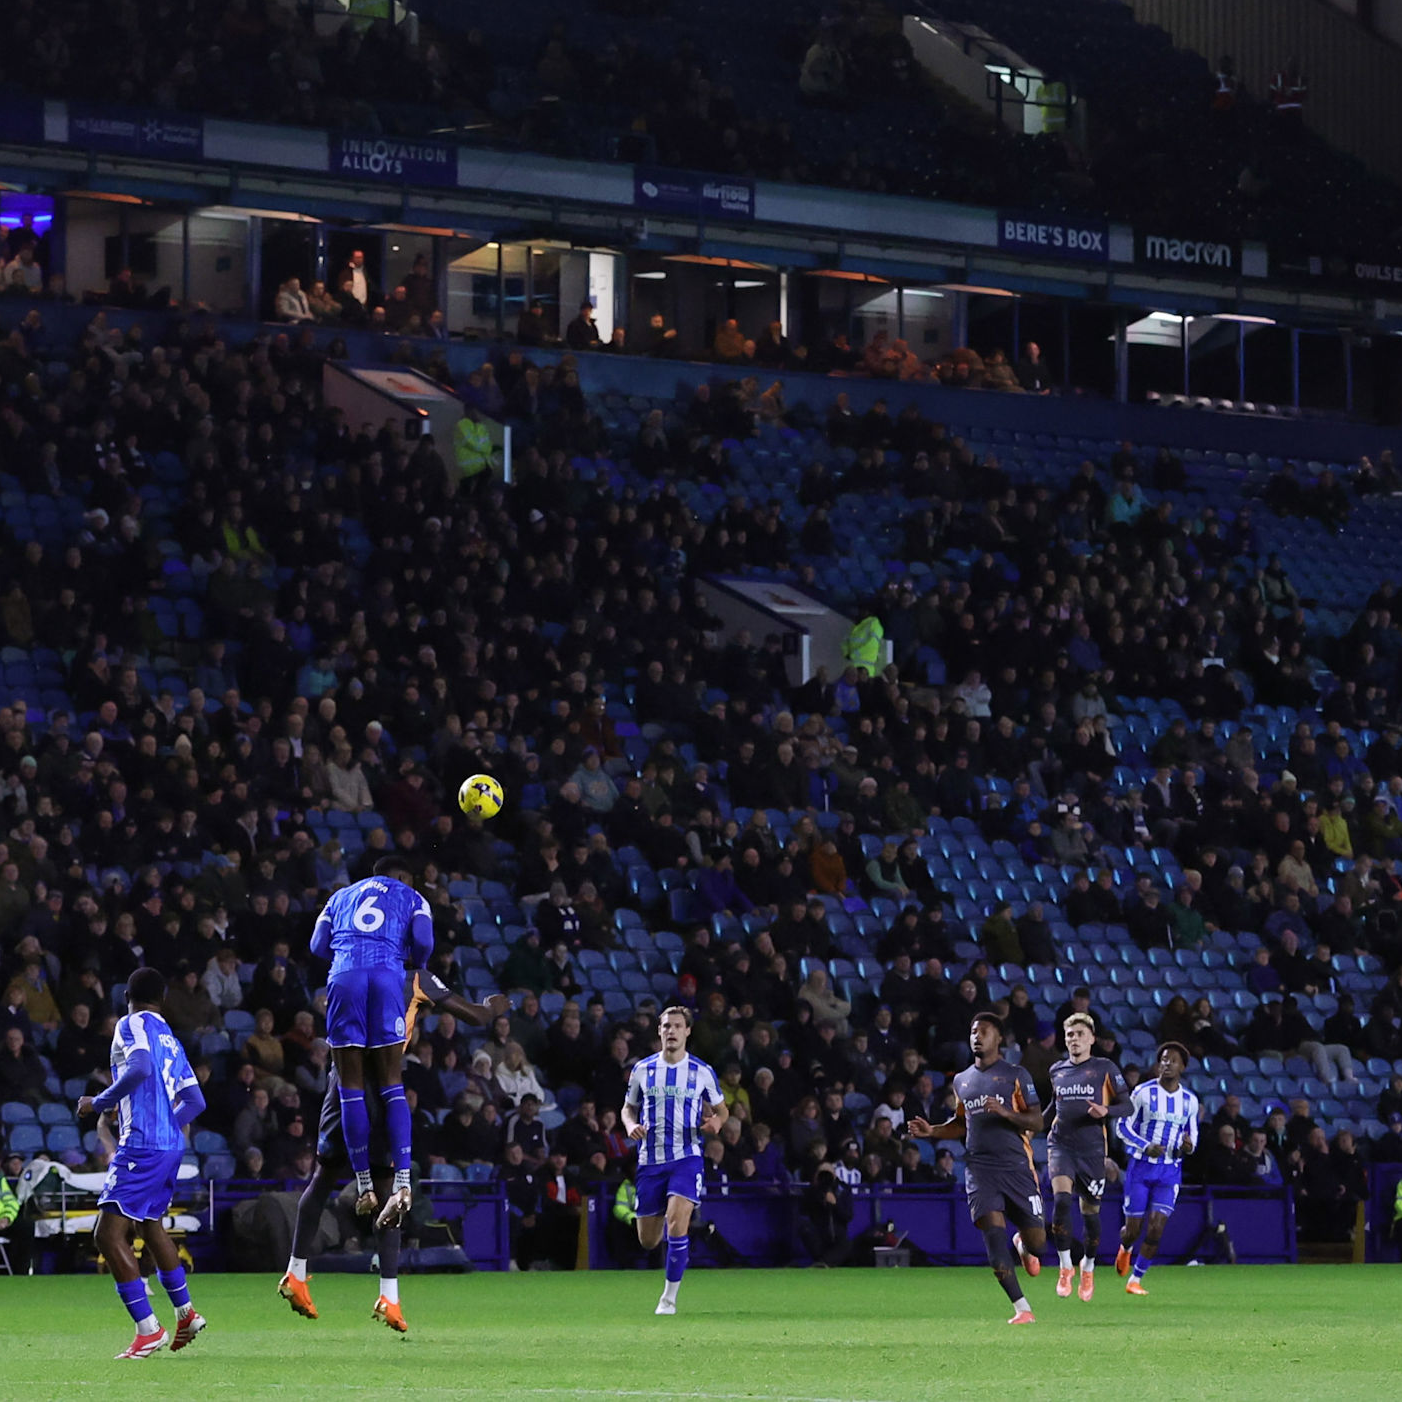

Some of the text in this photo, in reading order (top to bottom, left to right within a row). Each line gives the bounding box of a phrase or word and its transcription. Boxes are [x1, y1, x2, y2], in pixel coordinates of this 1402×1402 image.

[342, 139, 447, 163] INNOVATION
[342, 153, 403, 175] ALLOYS
[1004, 219, 1103, 252] BERE'S BOX
[1145, 235, 1233, 268] macron
[1355, 262, 1392, 282] OWLS
[353, 896, 385, 933] 6
